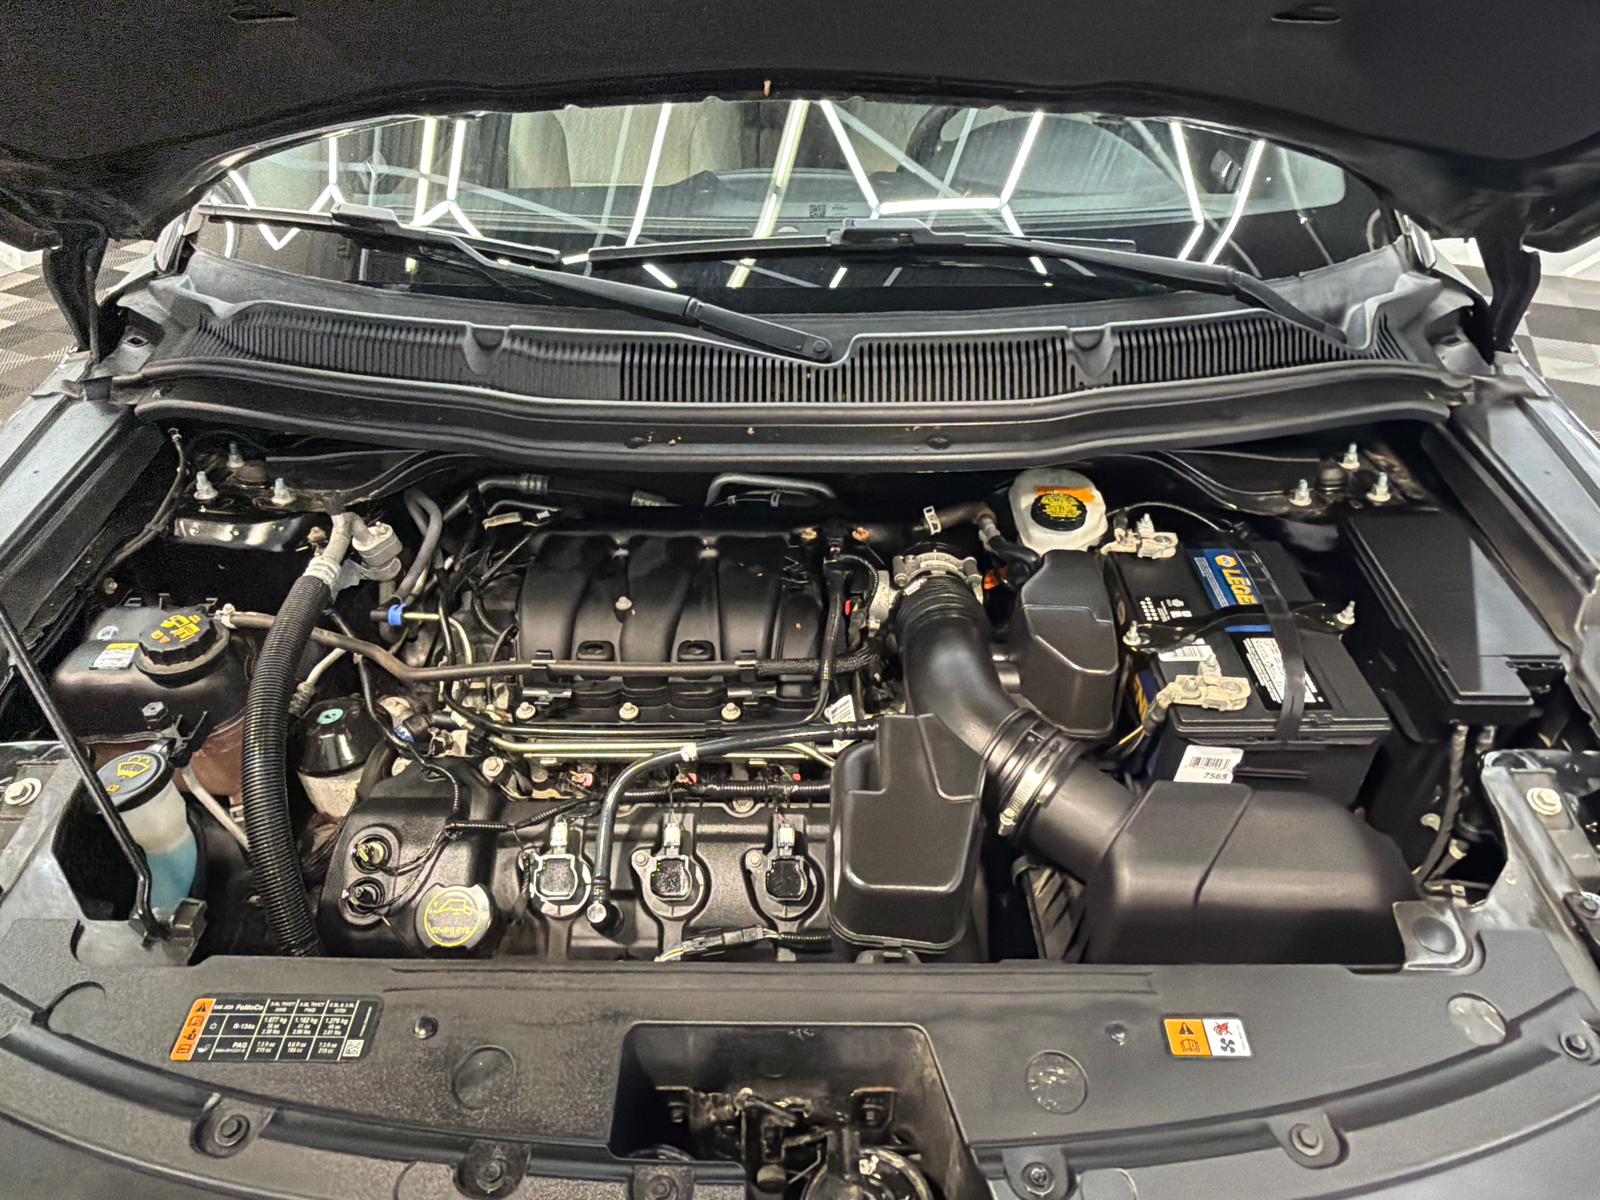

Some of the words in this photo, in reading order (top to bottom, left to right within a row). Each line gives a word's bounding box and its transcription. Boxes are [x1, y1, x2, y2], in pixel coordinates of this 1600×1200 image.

[1221, 568, 1258, 605] LEGE
[1203, 772, 1228, 781] 7565
[235, 1003, 264, 1011] FoMoCo
[232, 1022, 256, 1030] R-134a
[232, 1041, 248, 1049] PAG
